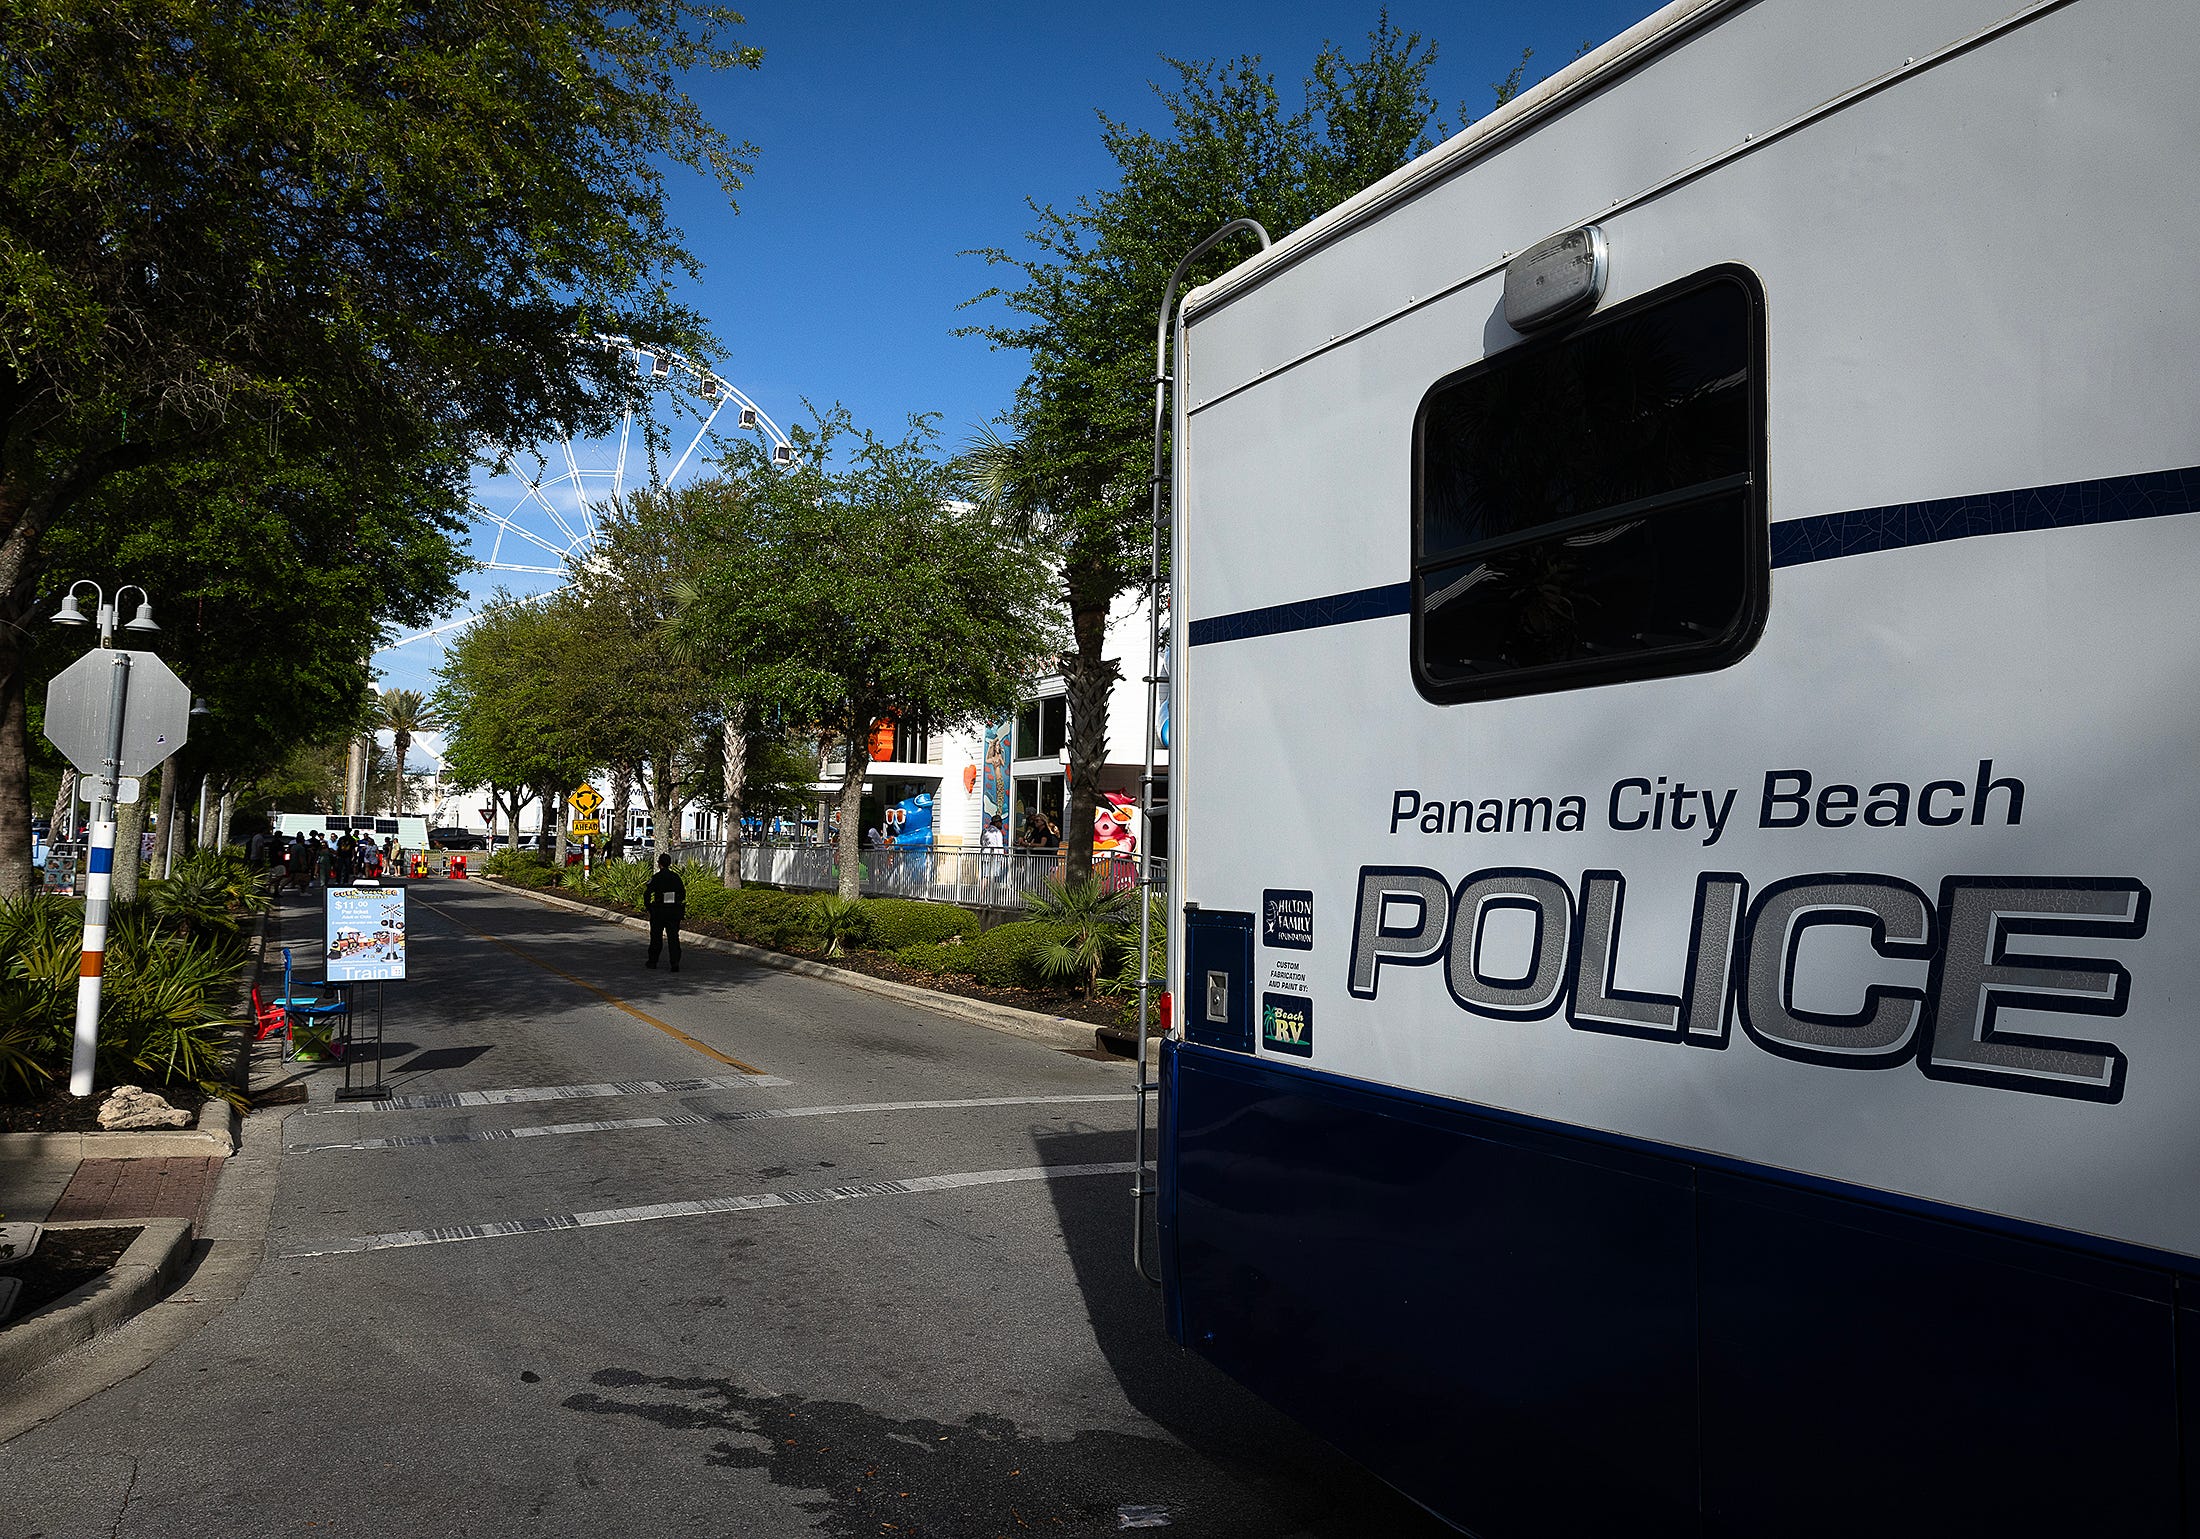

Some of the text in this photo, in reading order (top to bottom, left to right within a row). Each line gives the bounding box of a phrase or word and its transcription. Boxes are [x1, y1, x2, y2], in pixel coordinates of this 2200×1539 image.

[1390, 759, 2026, 847] Panama City Beach
[574, 823, 598, 831] AHEAD
[335, 901, 368, 910] $11.00
[1279, 900, 1311, 914] HILTON
[1279, 916, 1311, 932] FAMILY
[1278, 932, 1311, 943] FOUNDATION
[1276, 960, 1300, 970] CUSTOM
[341, 966, 389, 979] Train
[1270, 970, 1306, 981] FABRICATION
[1268, 980, 1309, 992] AND PAINT BY:
[1348, 864, 2152, 1105] POLICE
[1275, 1007, 1304, 1022] Beach
[1275, 1019, 1305, 1044] RV
